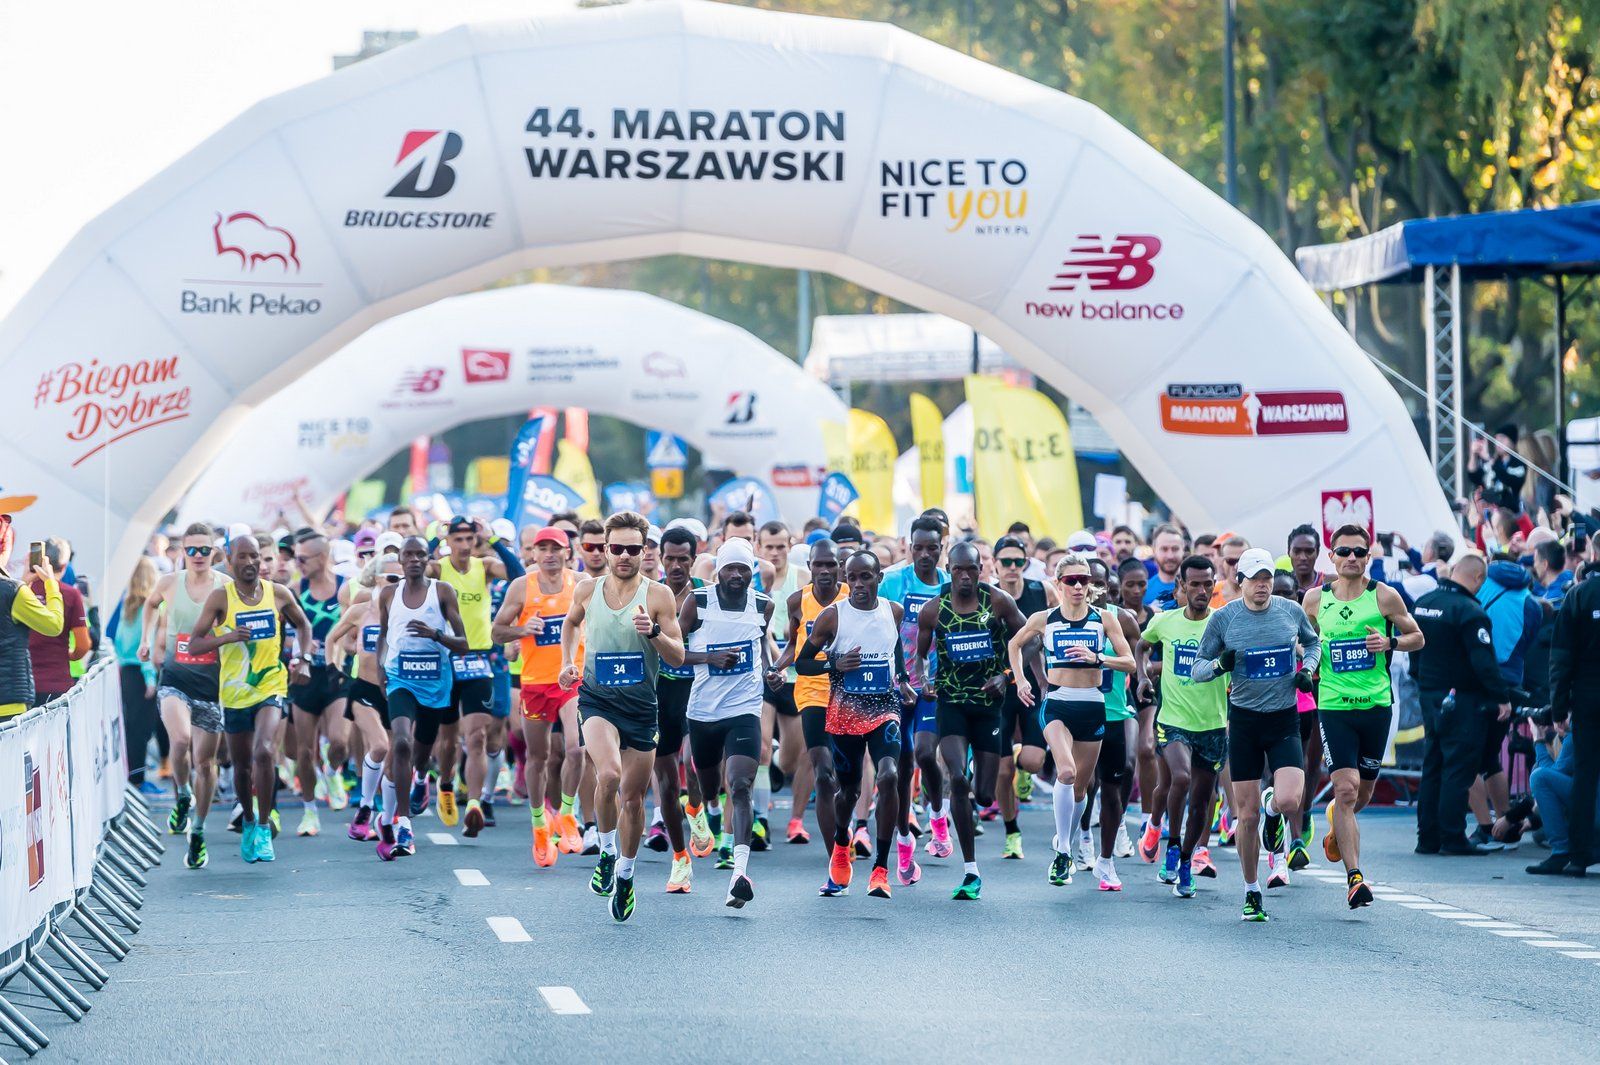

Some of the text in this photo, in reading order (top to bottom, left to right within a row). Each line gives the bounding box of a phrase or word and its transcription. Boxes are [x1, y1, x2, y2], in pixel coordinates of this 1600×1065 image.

[526, 107, 845, 141] 44. MARATON
[525, 148, 844, 181] WARSZAWSKI
[881, 160, 1027, 187] NICE TO
[345, 210, 496, 228] BRIDGESTONE
[881, 190, 1028, 232] FIT you
[181, 291, 322, 315] Bank Pekao
[1026, 300, 1184, 320] new balance
[1170, 404, 1345, 424] MARATON WARSZAWSKI
[951, 640, 989, 652] FREDERICK
[1346, 649, 1368, 660] 8899
[402, 661, 437, 671] DICKSON
[613, 664, 626, 675] 34
[1264, 657, 1276, 668] 33
[862, 671, 874, 682] 10
